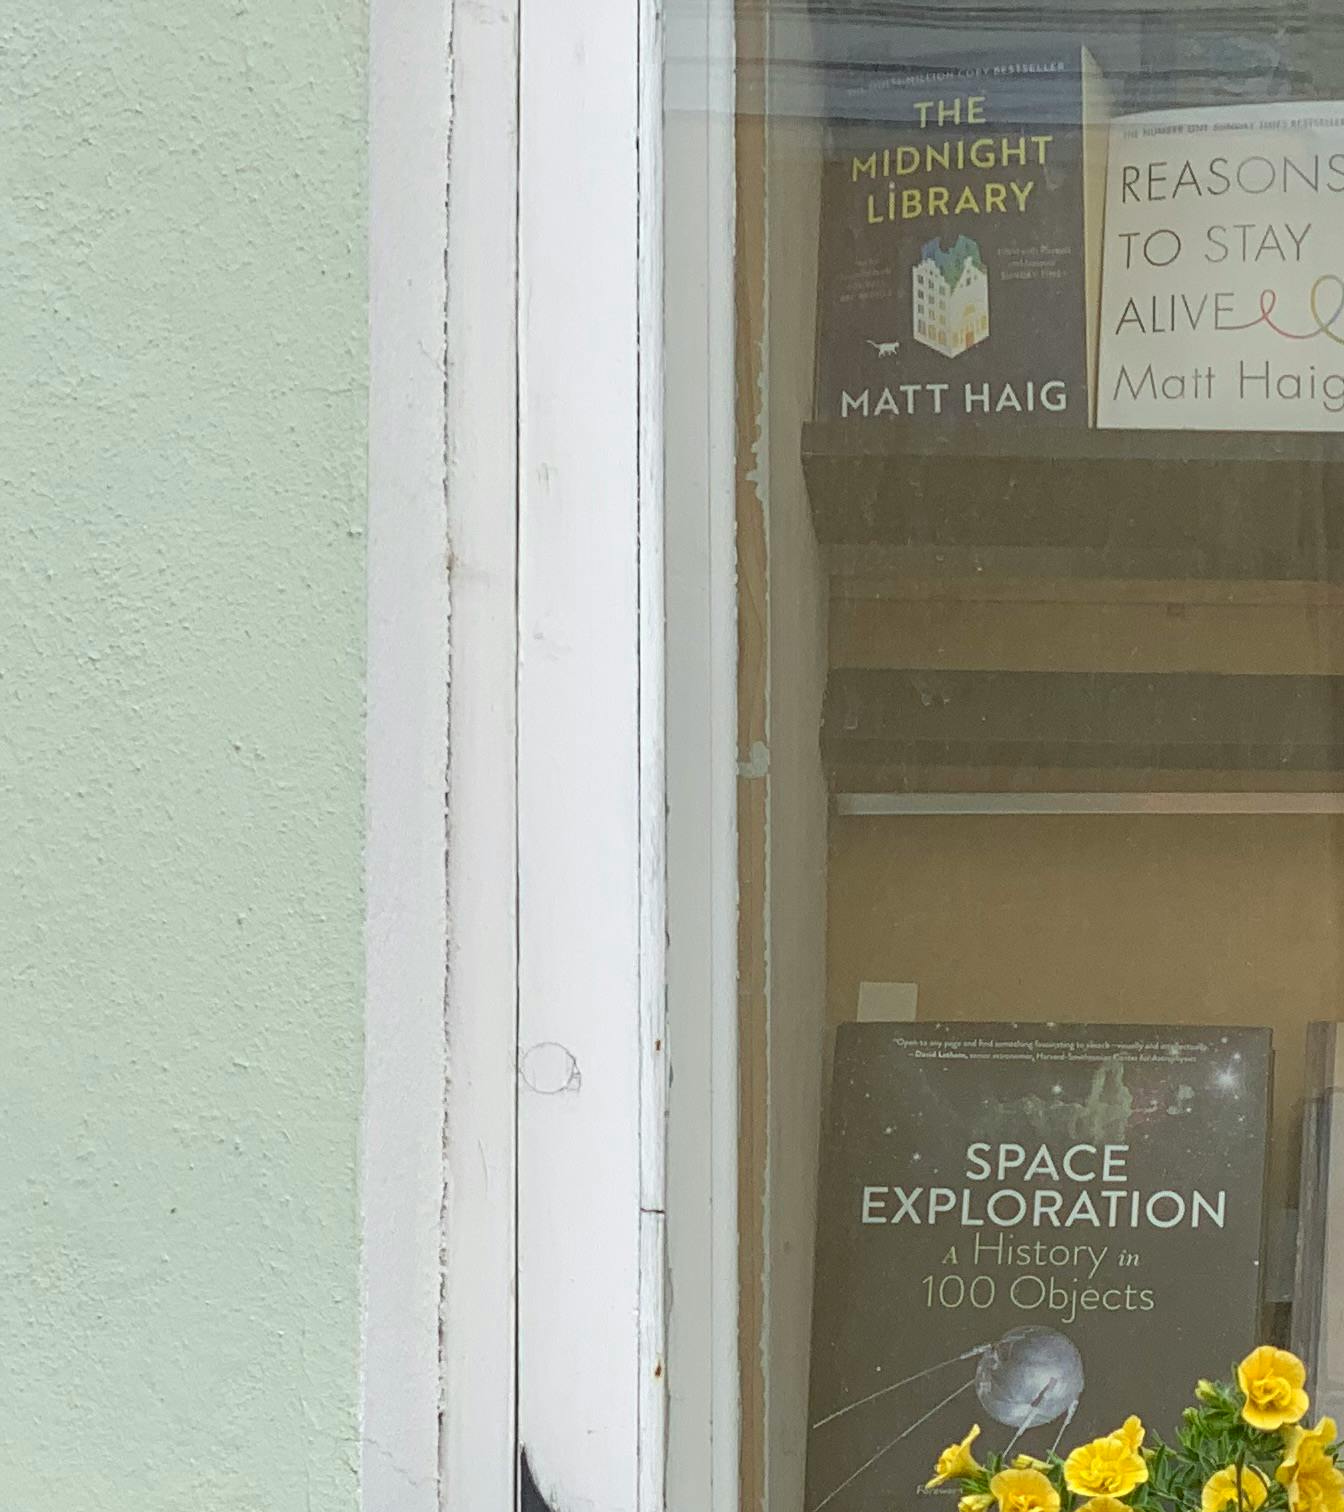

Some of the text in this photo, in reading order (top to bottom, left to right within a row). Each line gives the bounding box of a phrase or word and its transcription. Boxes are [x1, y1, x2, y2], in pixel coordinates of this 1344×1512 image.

[913, 96, 988, 129] THE
[852, 135, 1053, 182] MIDNIGHT
[867, 179, 1035, 225] LIBRARY
[1118, 229, 1182, 271] TO
[1204, 222, 1313, 265] STAY
[841, 380, 1068, 418] MATT HAIG
[1112, 364, 1217, 401] Matt
[966, 1143, 1131, 1183] SPACE
[861, 1186, 1227, 1230] EXPLORATION
[973, 1232, 1109, 1280] History
[921, 1275, 1156, 1324] 100 Objects
